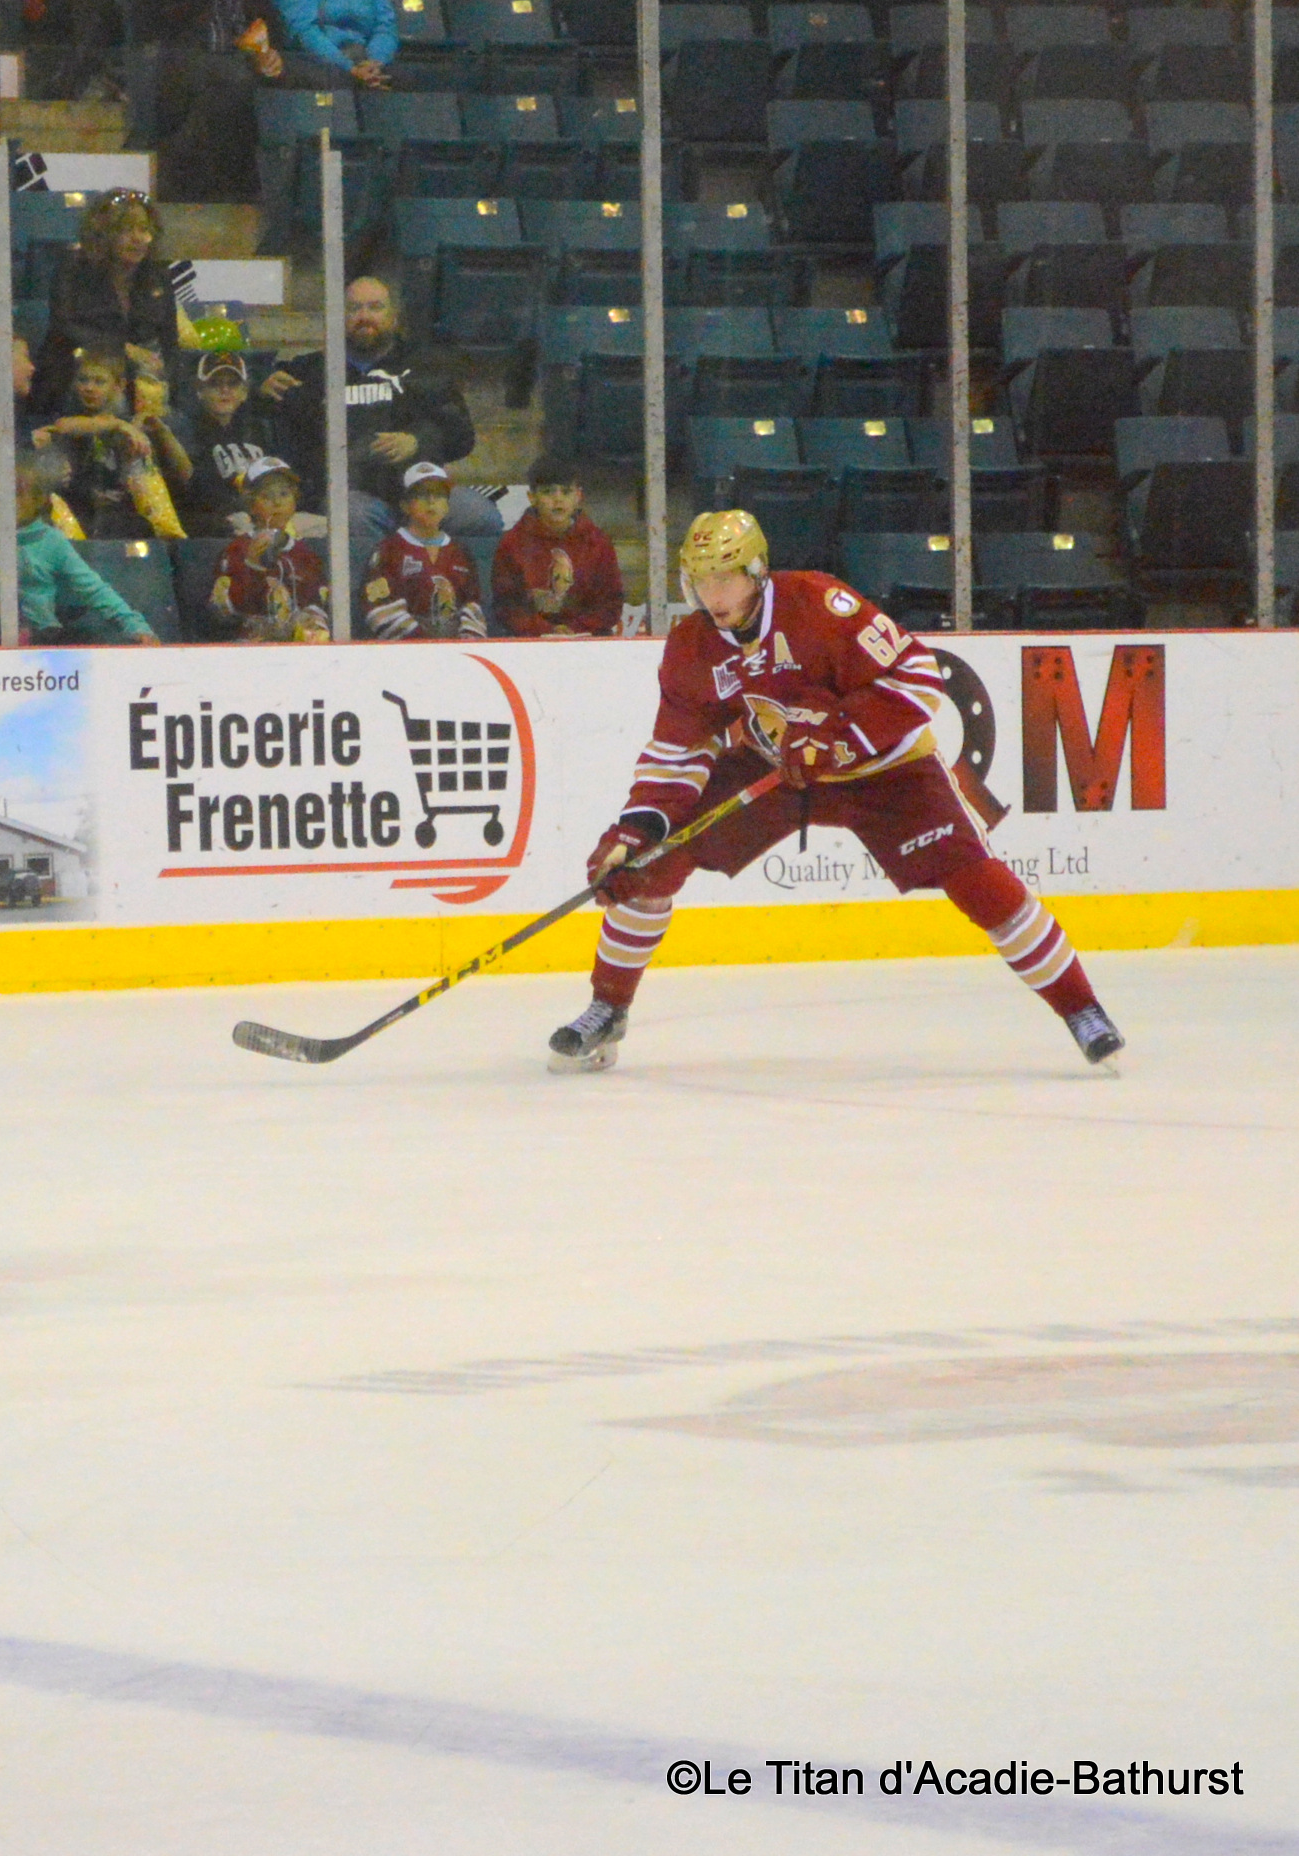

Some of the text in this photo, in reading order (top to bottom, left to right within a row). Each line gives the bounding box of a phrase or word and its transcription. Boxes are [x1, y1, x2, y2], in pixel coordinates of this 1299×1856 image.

[773, 631, 795, 665] A
[857, 613, 914, 668] 62
[128, 686, 362, 779] Épicerie
[165, 781, 402, 853] Frenette
[899, 822, 954, 856] CCM
[762, 852, 855, 892] Quality
[1047, 846, 1090, 877] Ltd
